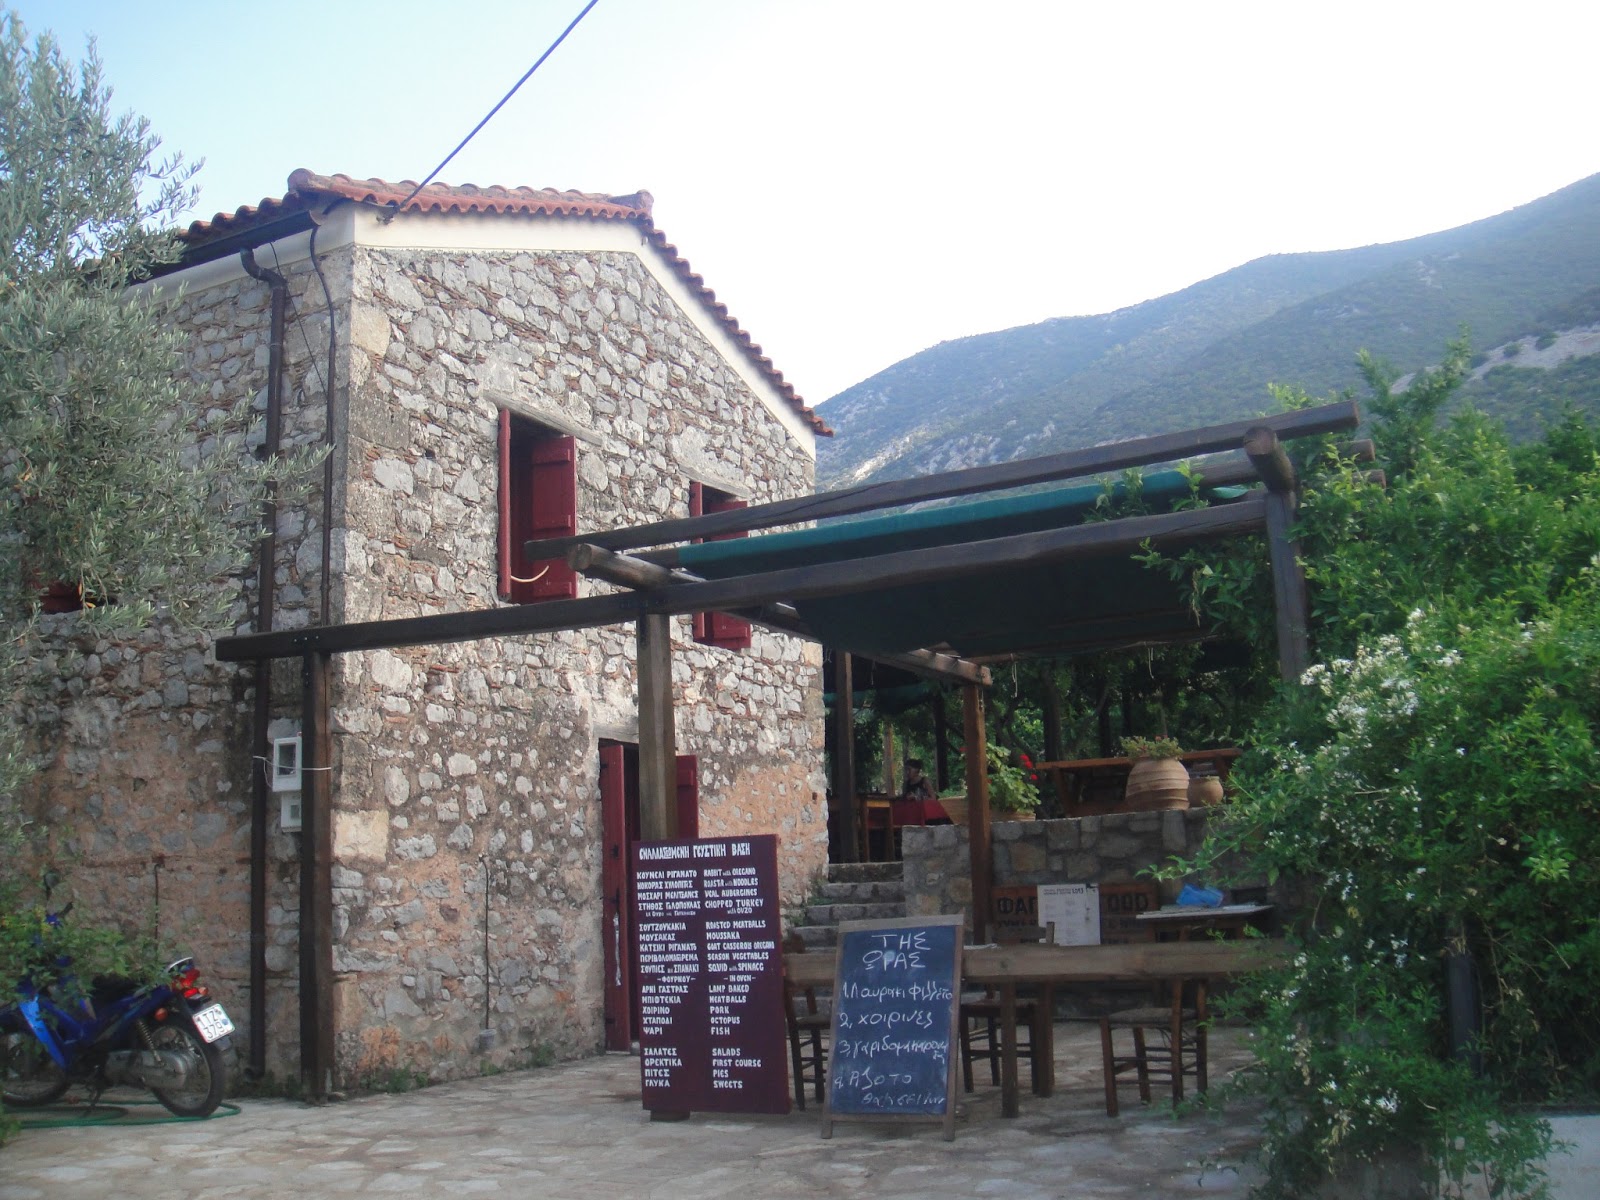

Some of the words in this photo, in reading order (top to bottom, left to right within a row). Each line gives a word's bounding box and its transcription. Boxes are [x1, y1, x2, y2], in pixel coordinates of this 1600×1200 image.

[693, 844, 726, 858] ΓΕΥΣΤΙΚΗ
[732, 842, 750, 856] ΒΑΣΗ
[636, 872, 664, 880] ΚΟΥΝΕΛΙ
[666, 870, 697, 878] ΡΙΓΑΝΑΤΟ
[704, 869, 722, 877] RABBIT
[637, 881, 664, 890] ΚΟΚΟΡΑΣ
[733, 878, 758, 886] NOODLES
[638, 892, 662, 900] ΜΟΣΧΑΡΙ
[704, 890, 719, 898] VEAL
[722, 889, 758, 897] AUBERGINES
[638, 902, 663, 910] ΣΤΗΘΟΣ
[705, 900, 733, 908] CHOPPED
[736, 898, 764, 907] TURKEY
[639, 922, 686, 931] ΣΟΥΤΖΟΥΚΑΚΙΑ
[706, 921, 730, 930] ROASTED
[733, 920, 766, 929] MEATBALLS
[639, 933, 676, 941] ΜΟΥΣΑΚΑΣ
[706, 932, 740, 940] MOUSSAKA
[872, 931, 931, 951] ΤΗΣ
[640, 943, 665, 952] ΚΑΤΣΙΚΙ
[669, 943, 697, 951] ΡΙΓΑΝΑΤΟ
[708, 953, 730, 961] SEASON
[732, 952, 769, 960] VEGETABLES
[862, 950, 926, 972] ΩΡΑΣ
[640, 965, 665, 973] ΣΟΥΠΙΕΣ
[673, 964, 699, 973] ΣΠΑΝΑΚΙ
[642, 985, 656, 994] ΑΡΝΙ
[659, 985, 688, 993] ΓΑΣΤΡΑΣ
[204, 1022, 225, 1038] 379
[645, 1058, 682, 1066] ΟΡΕΚΤΙΚΑ
